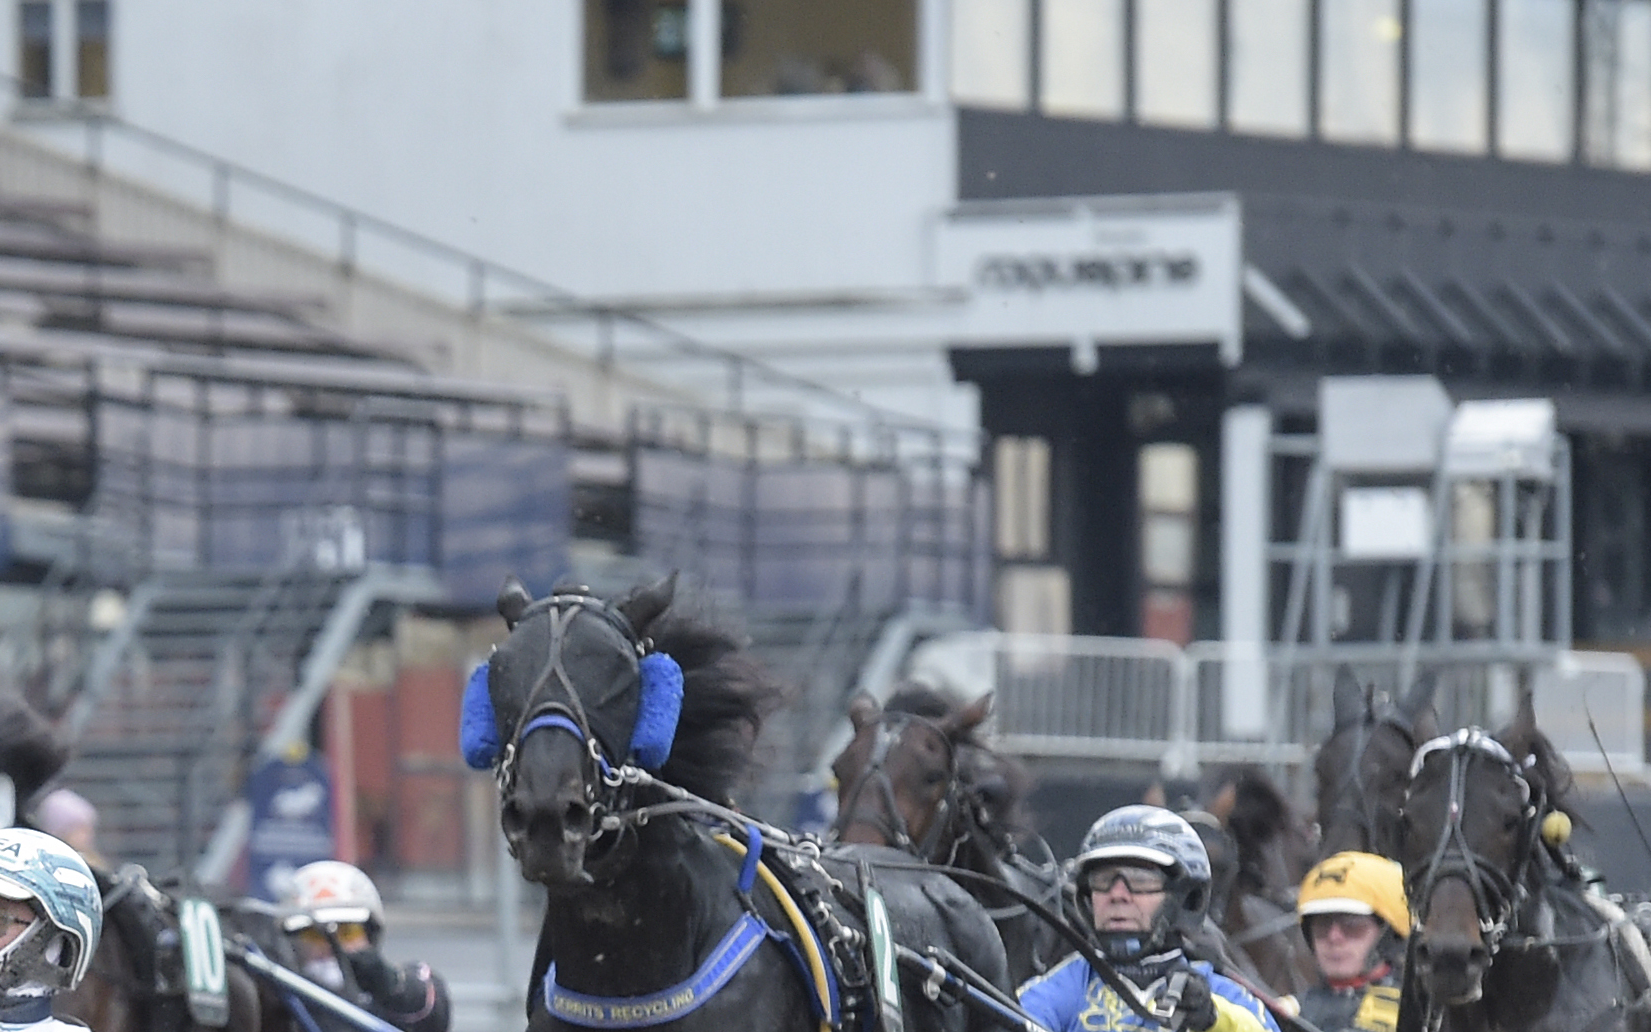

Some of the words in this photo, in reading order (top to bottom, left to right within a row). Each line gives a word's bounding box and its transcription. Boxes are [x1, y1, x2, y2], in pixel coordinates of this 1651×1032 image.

[180, 899, 225, 994] 10
[873, 896, 899, 1008] 2
[610, 987, 695, 1020] RECYCLING
